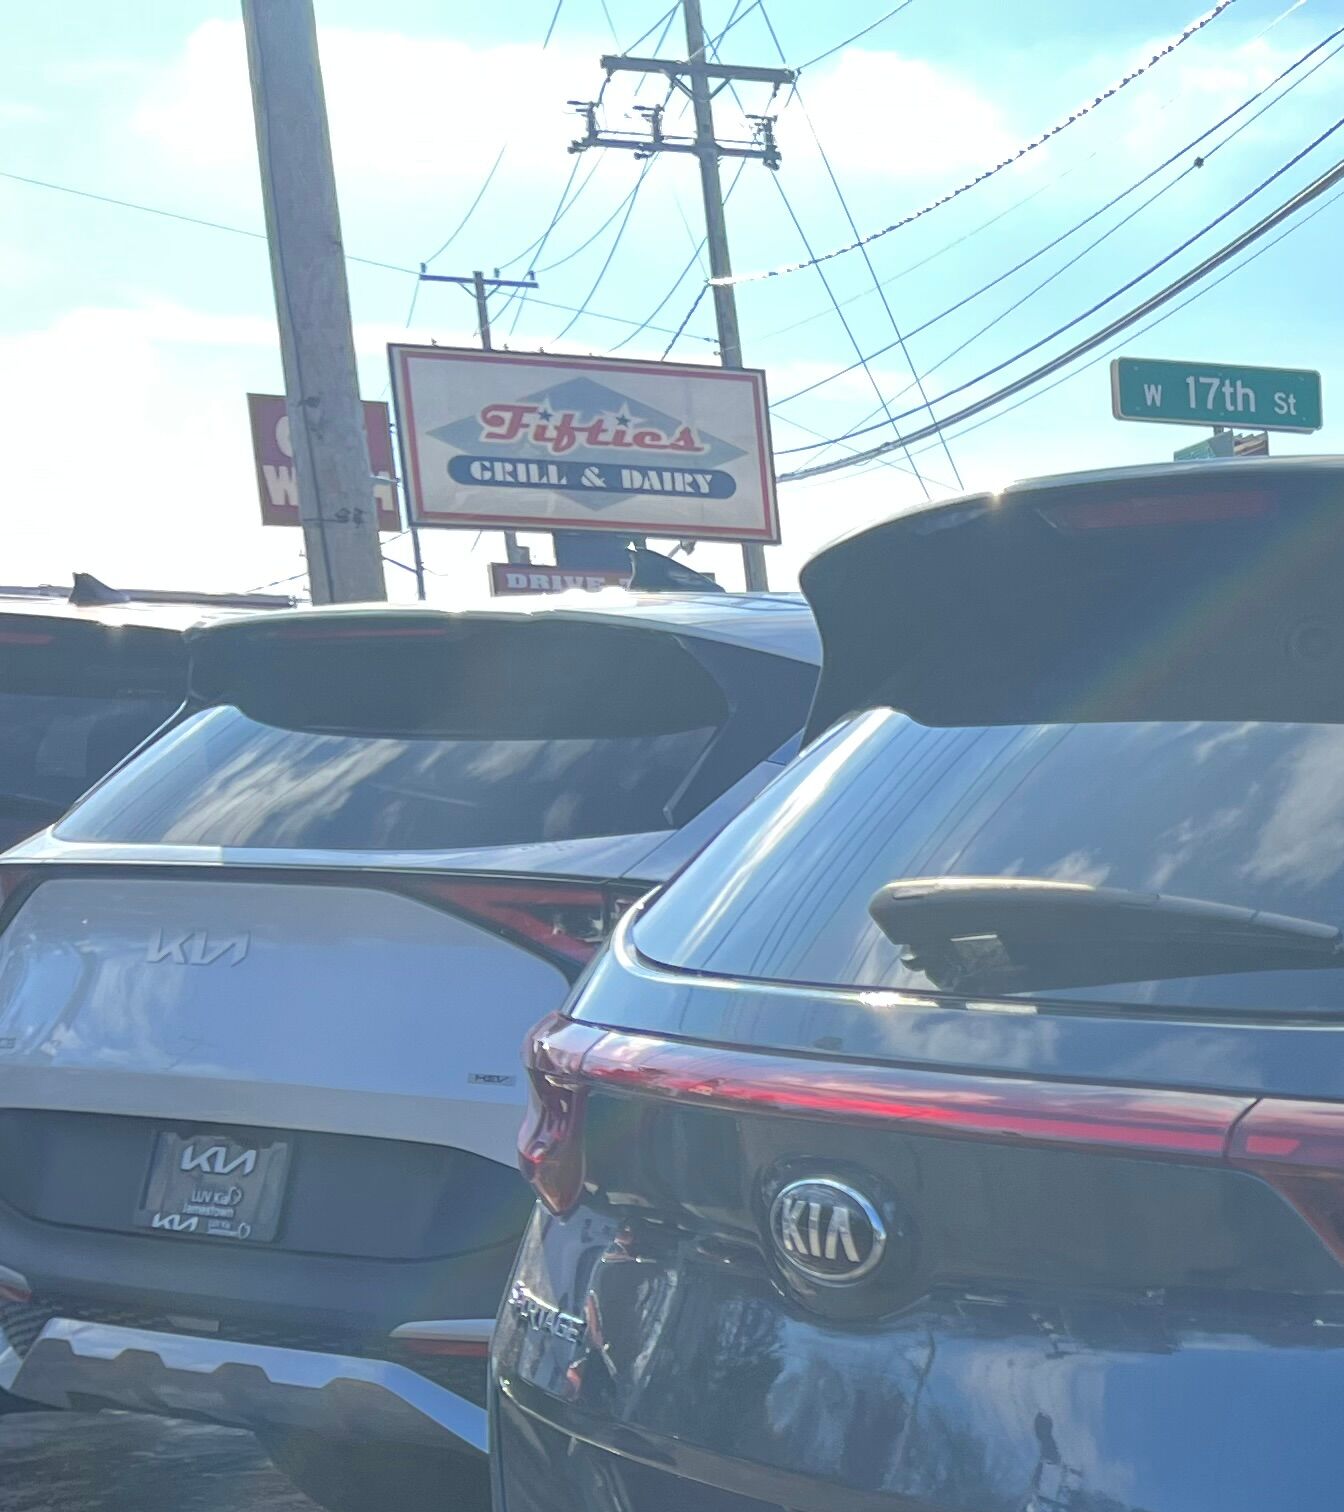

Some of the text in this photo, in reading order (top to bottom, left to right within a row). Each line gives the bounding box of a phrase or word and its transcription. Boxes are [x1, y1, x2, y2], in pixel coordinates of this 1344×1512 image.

[1143, 375, 1297, 416] W 17th St
[480, 403, 705, 453] Fifties
[469, 460, 713, 494] GRILL & DAIRY
[505, 572, 605, 593] DRIVE
[781, 1198, 860, 1262] KIA
